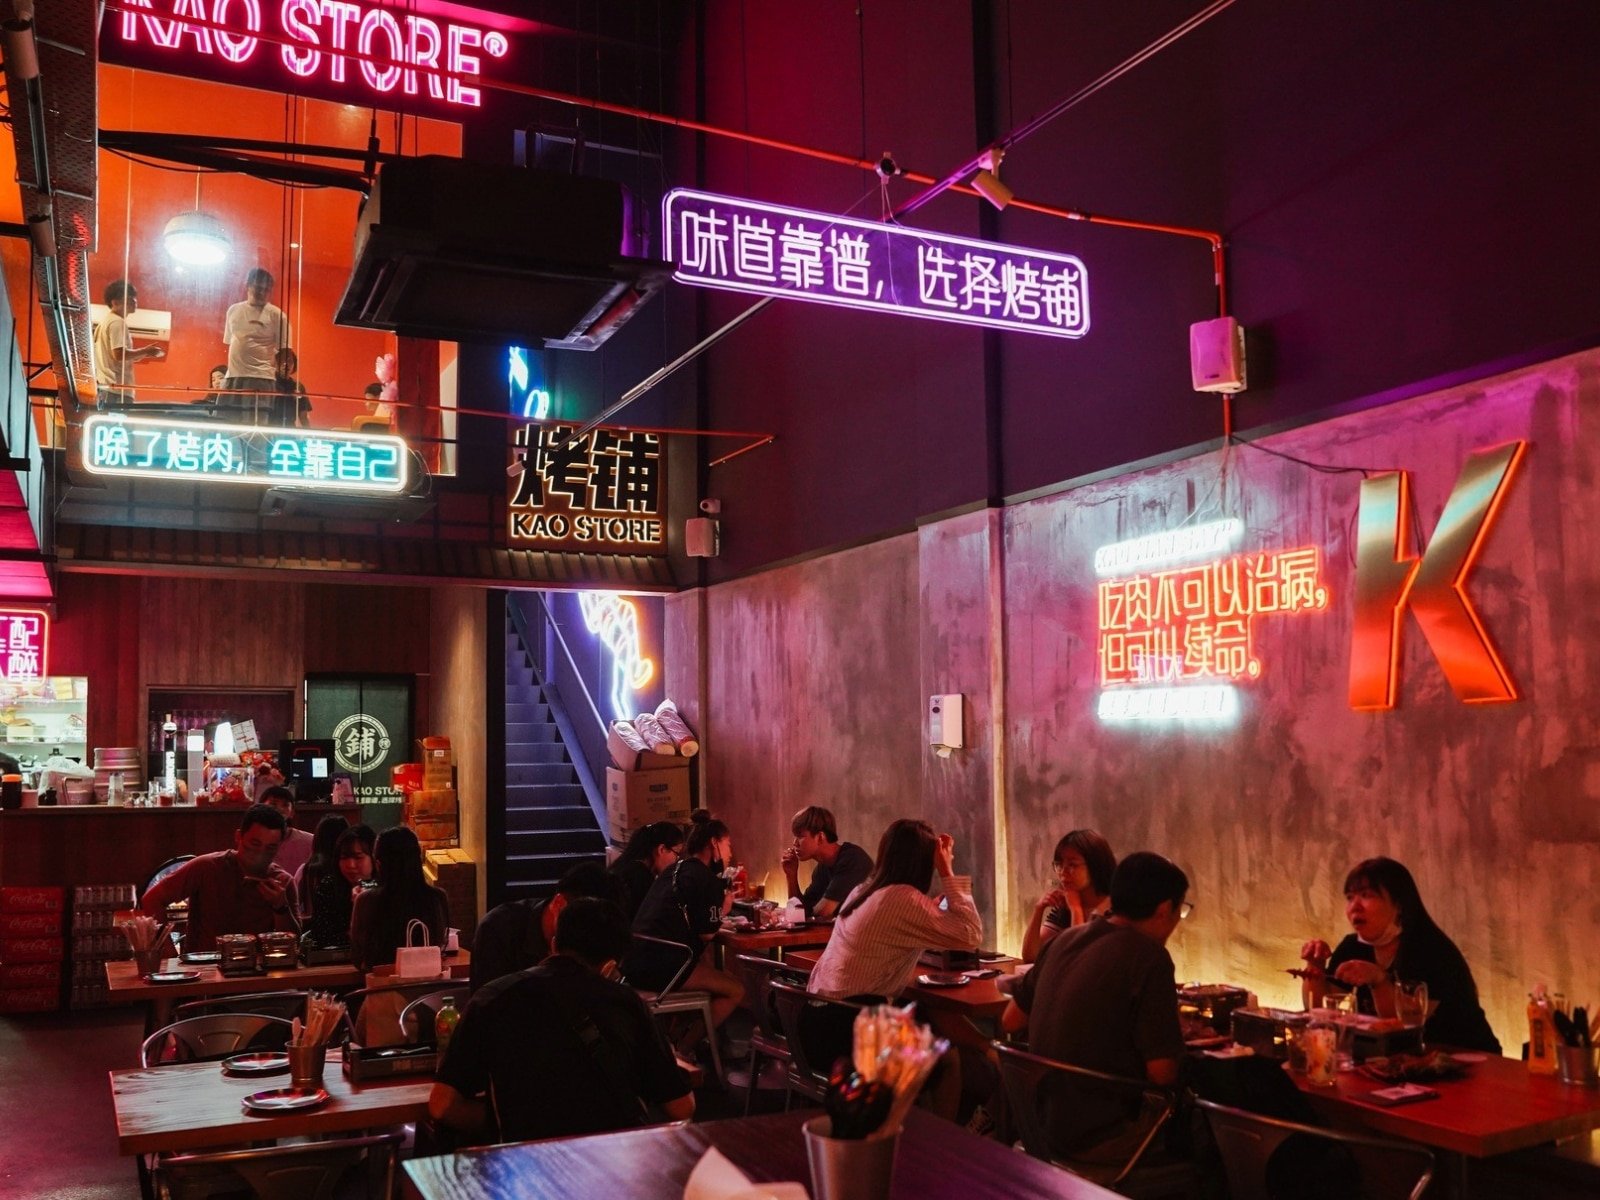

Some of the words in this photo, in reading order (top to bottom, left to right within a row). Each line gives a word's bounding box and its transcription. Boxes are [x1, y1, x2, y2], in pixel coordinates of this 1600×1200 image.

[511, 513, 570, 539] KAO
[575, 515, 661, 543] STORE
[1350, 439, 1527, 710] K
